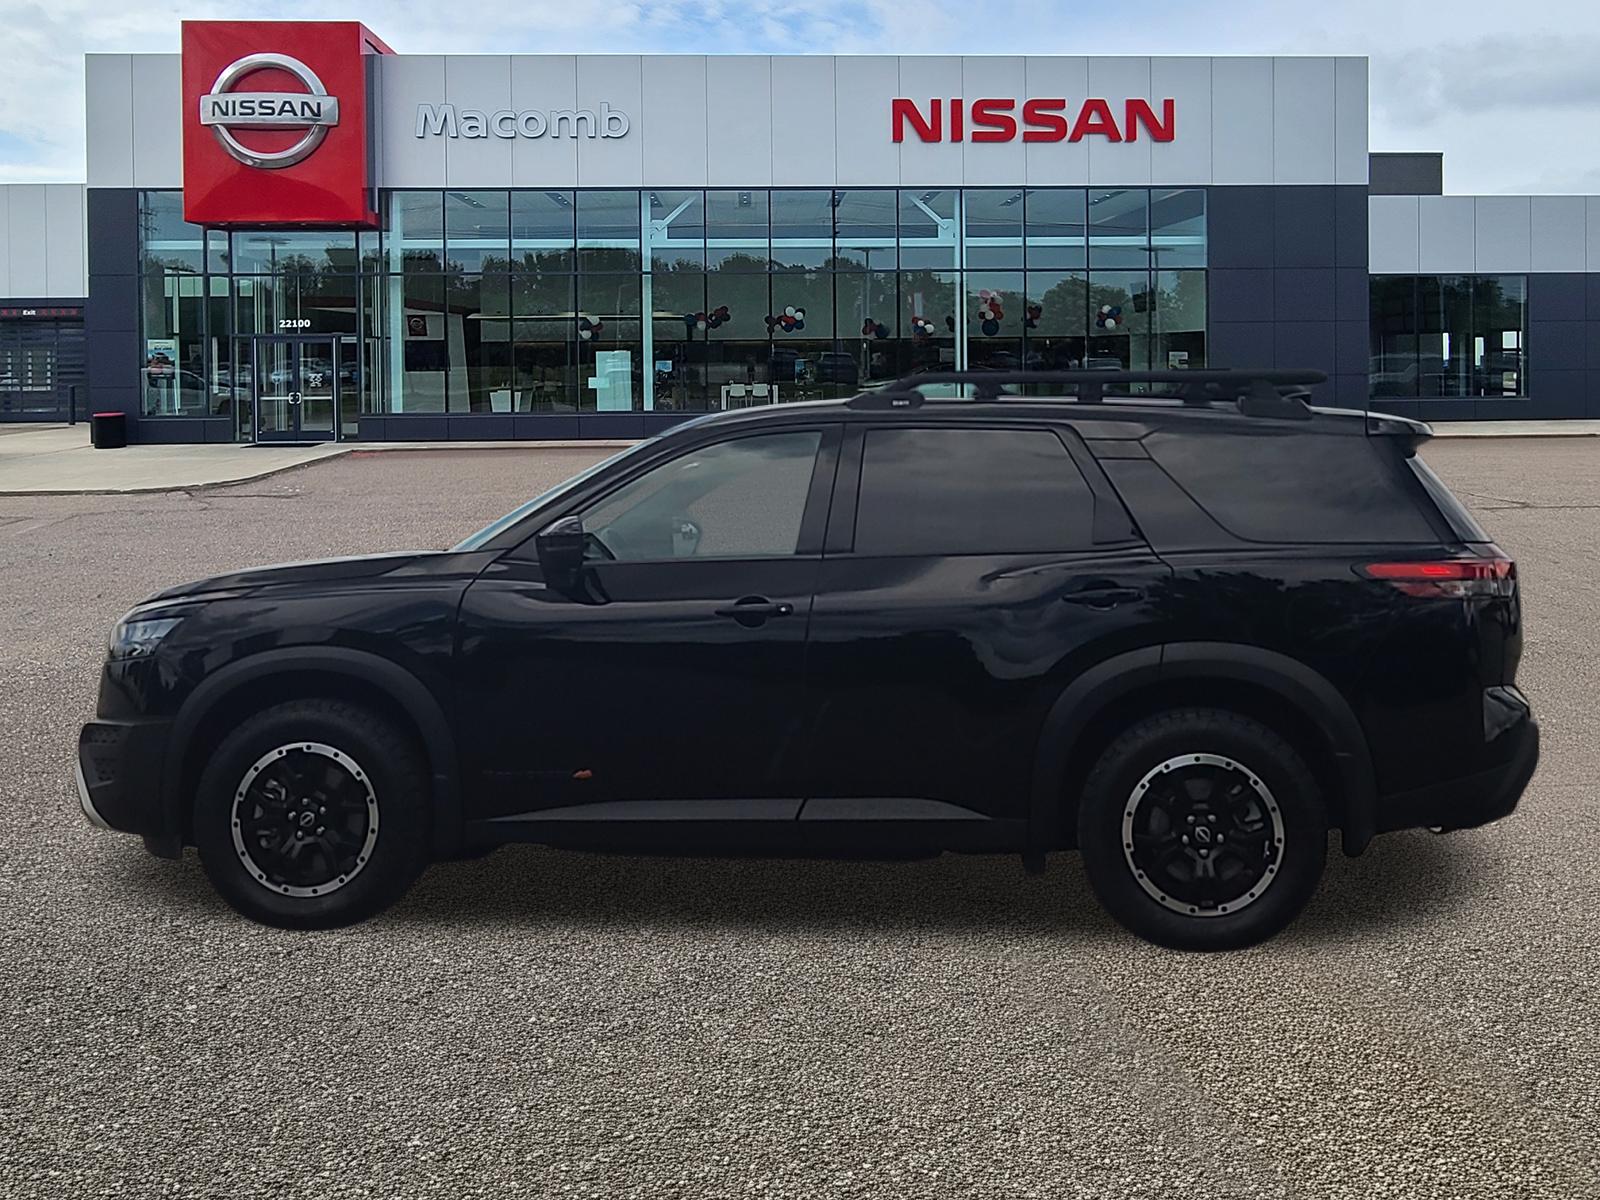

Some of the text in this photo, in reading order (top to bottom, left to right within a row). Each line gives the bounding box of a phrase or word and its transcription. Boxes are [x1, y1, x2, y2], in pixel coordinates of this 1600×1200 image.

[210, 99, 322, 118] NISSAN
[415, 101, 631, 139] Macomb
[892, 98, 1176, 143] NISSAN
[278, 319, 311, 328] 22100
